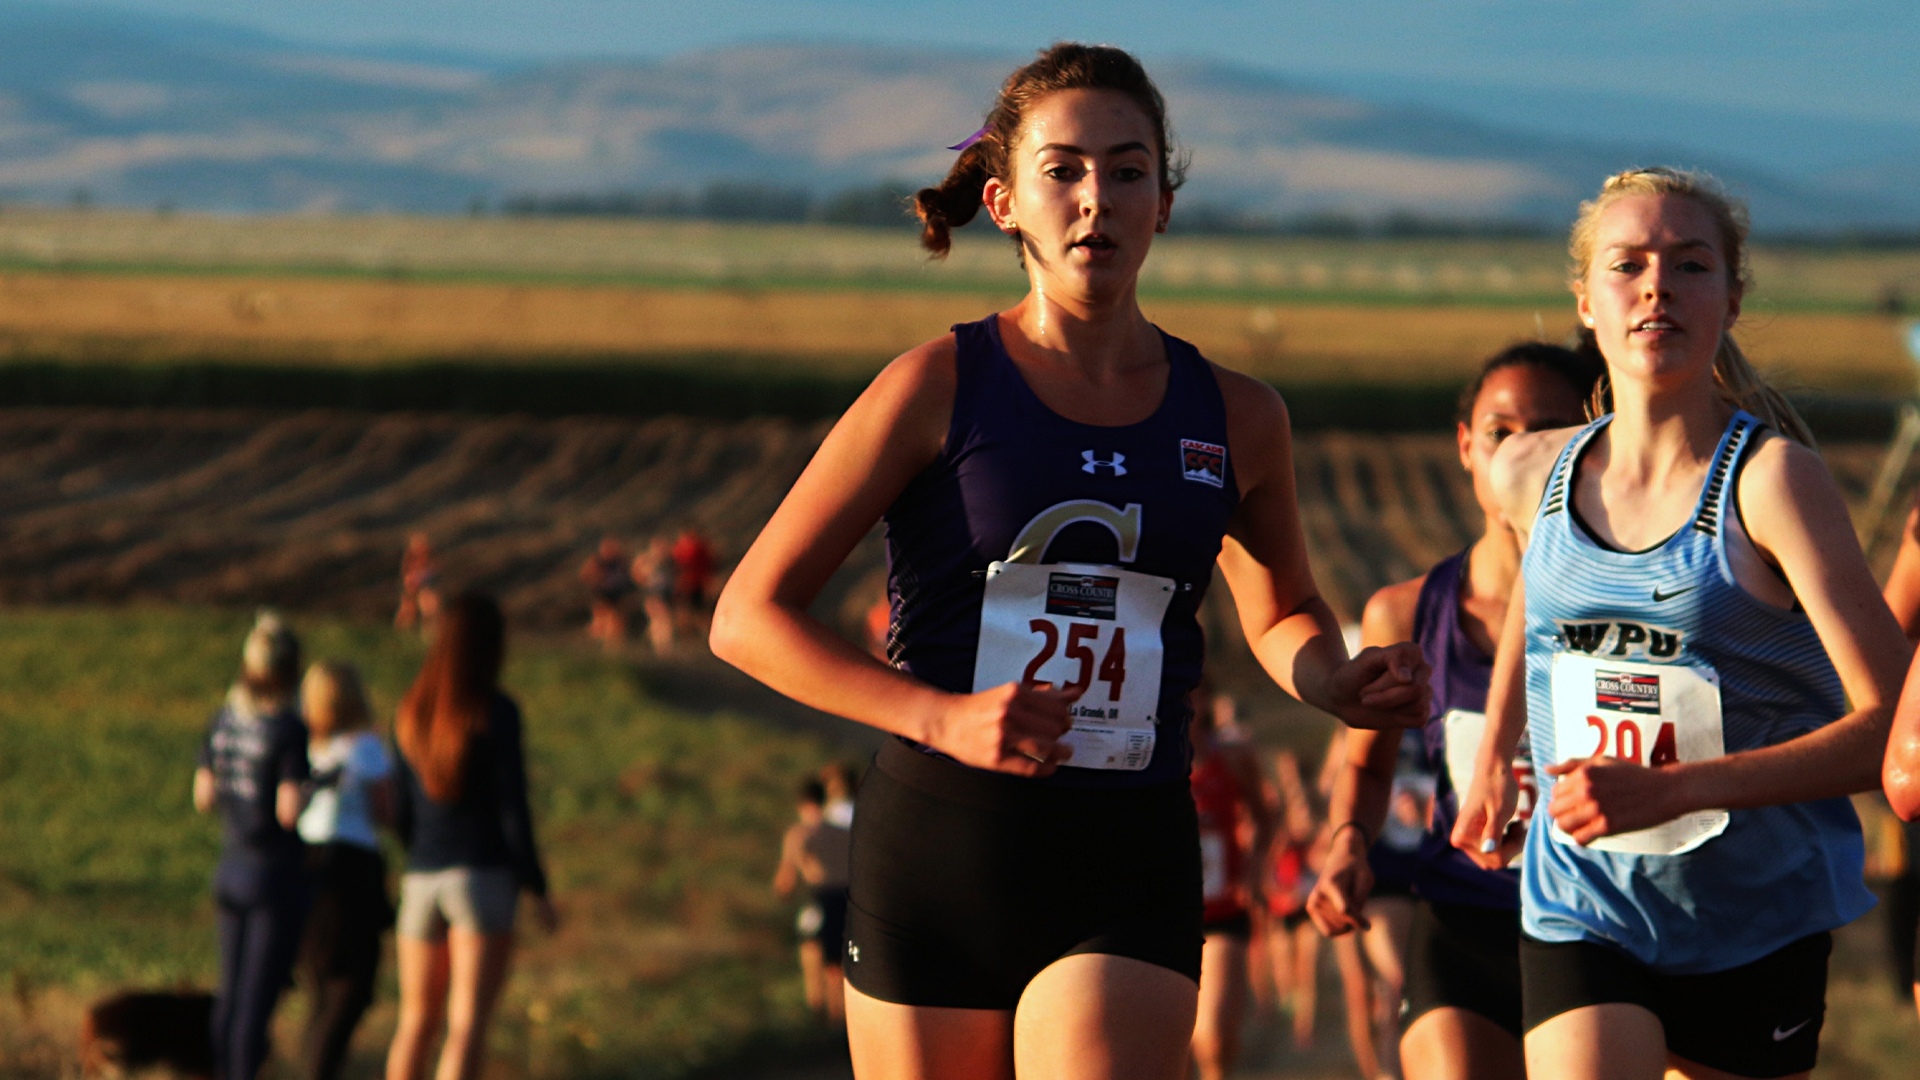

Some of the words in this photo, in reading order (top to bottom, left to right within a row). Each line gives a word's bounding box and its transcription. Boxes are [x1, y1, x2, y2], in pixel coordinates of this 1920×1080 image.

[1050, 583, 1079, 595] CROSS
[1080, 586, 1115, 598] COUNTRY
[1553, 618, 1684, 662] WPU
[1021, 618, 1126, 702] 254
[1596, 679, 1619, 691] CROSS
[1620, 682, 1658, 694] COUNTRY
